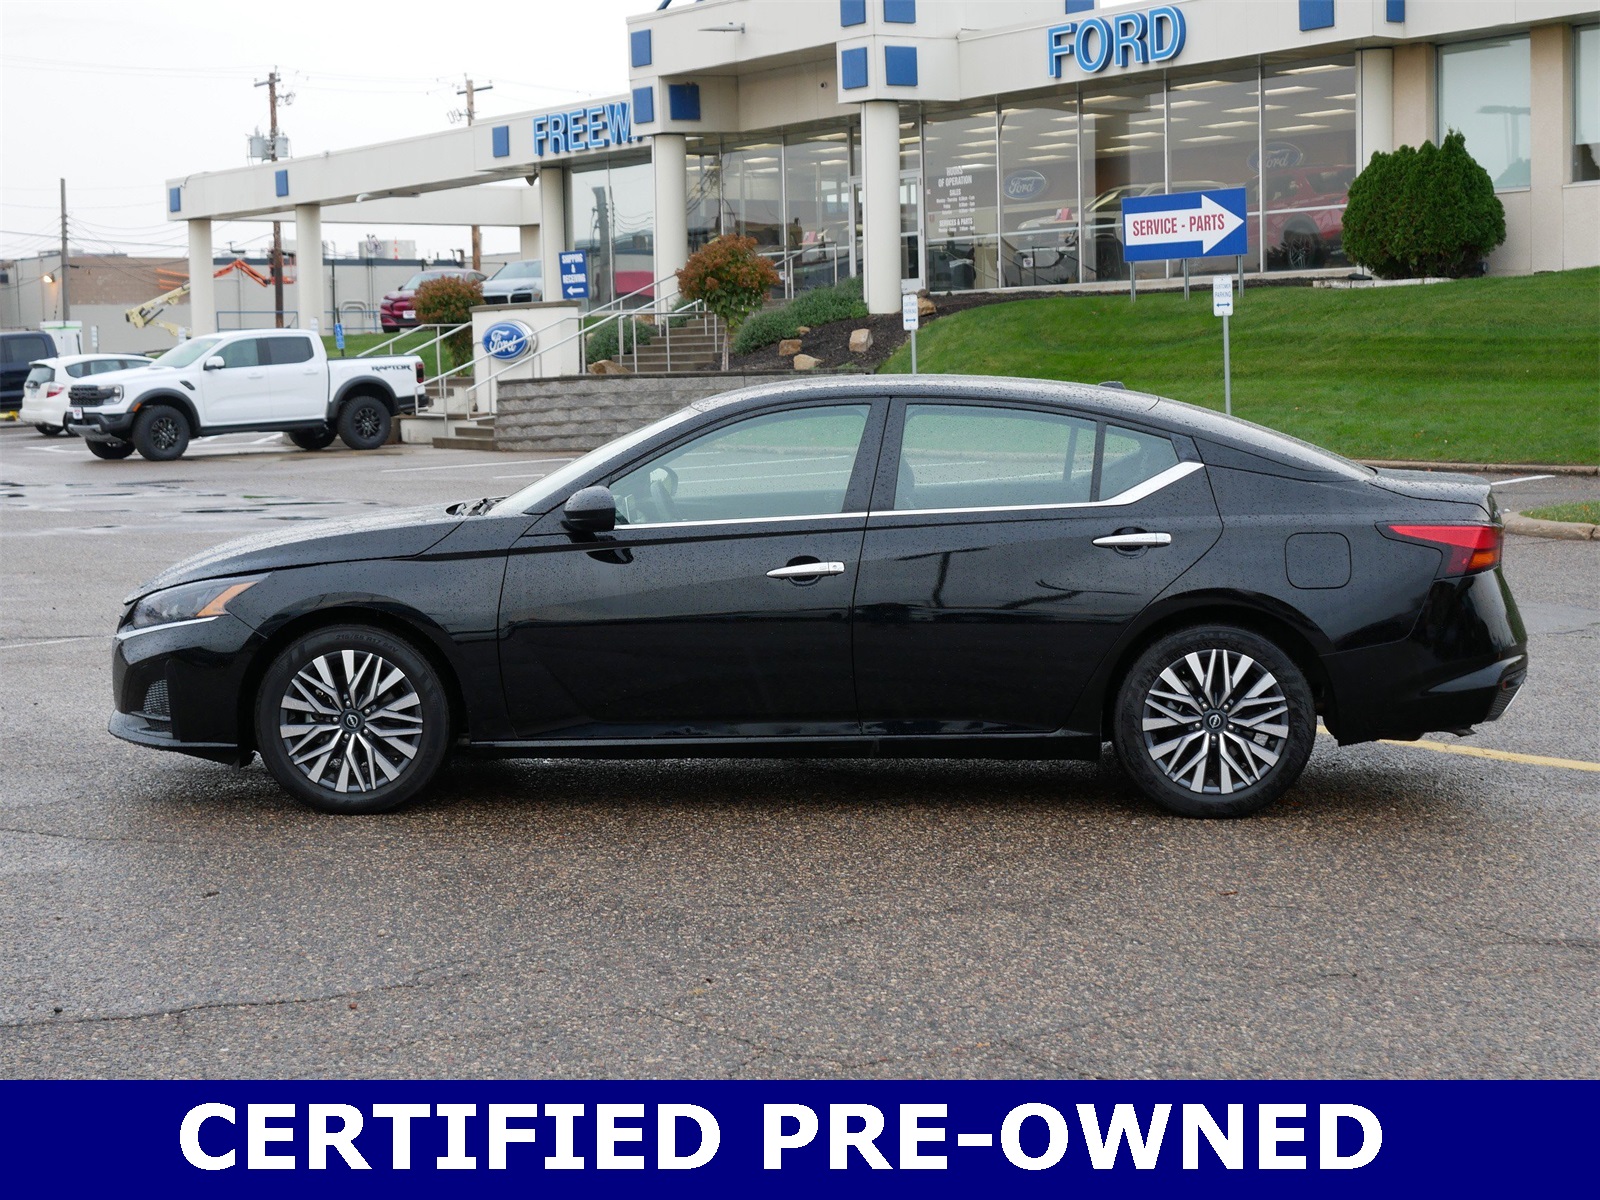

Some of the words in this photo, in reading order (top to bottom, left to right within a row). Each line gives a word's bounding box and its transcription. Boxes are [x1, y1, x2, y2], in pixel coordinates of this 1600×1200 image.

[1047, 5, 1187, 79] FORD
[533, 101, 643, 156] FREEW
[1008, 176, 1036, 194] Ford
[1132, 217, 1178, 237] SERVICE
[1189, 213, 1225, 232] PARTS
[489, 329, 517, 352] Ford
[371, 364, 413, 372] RAPTOR
